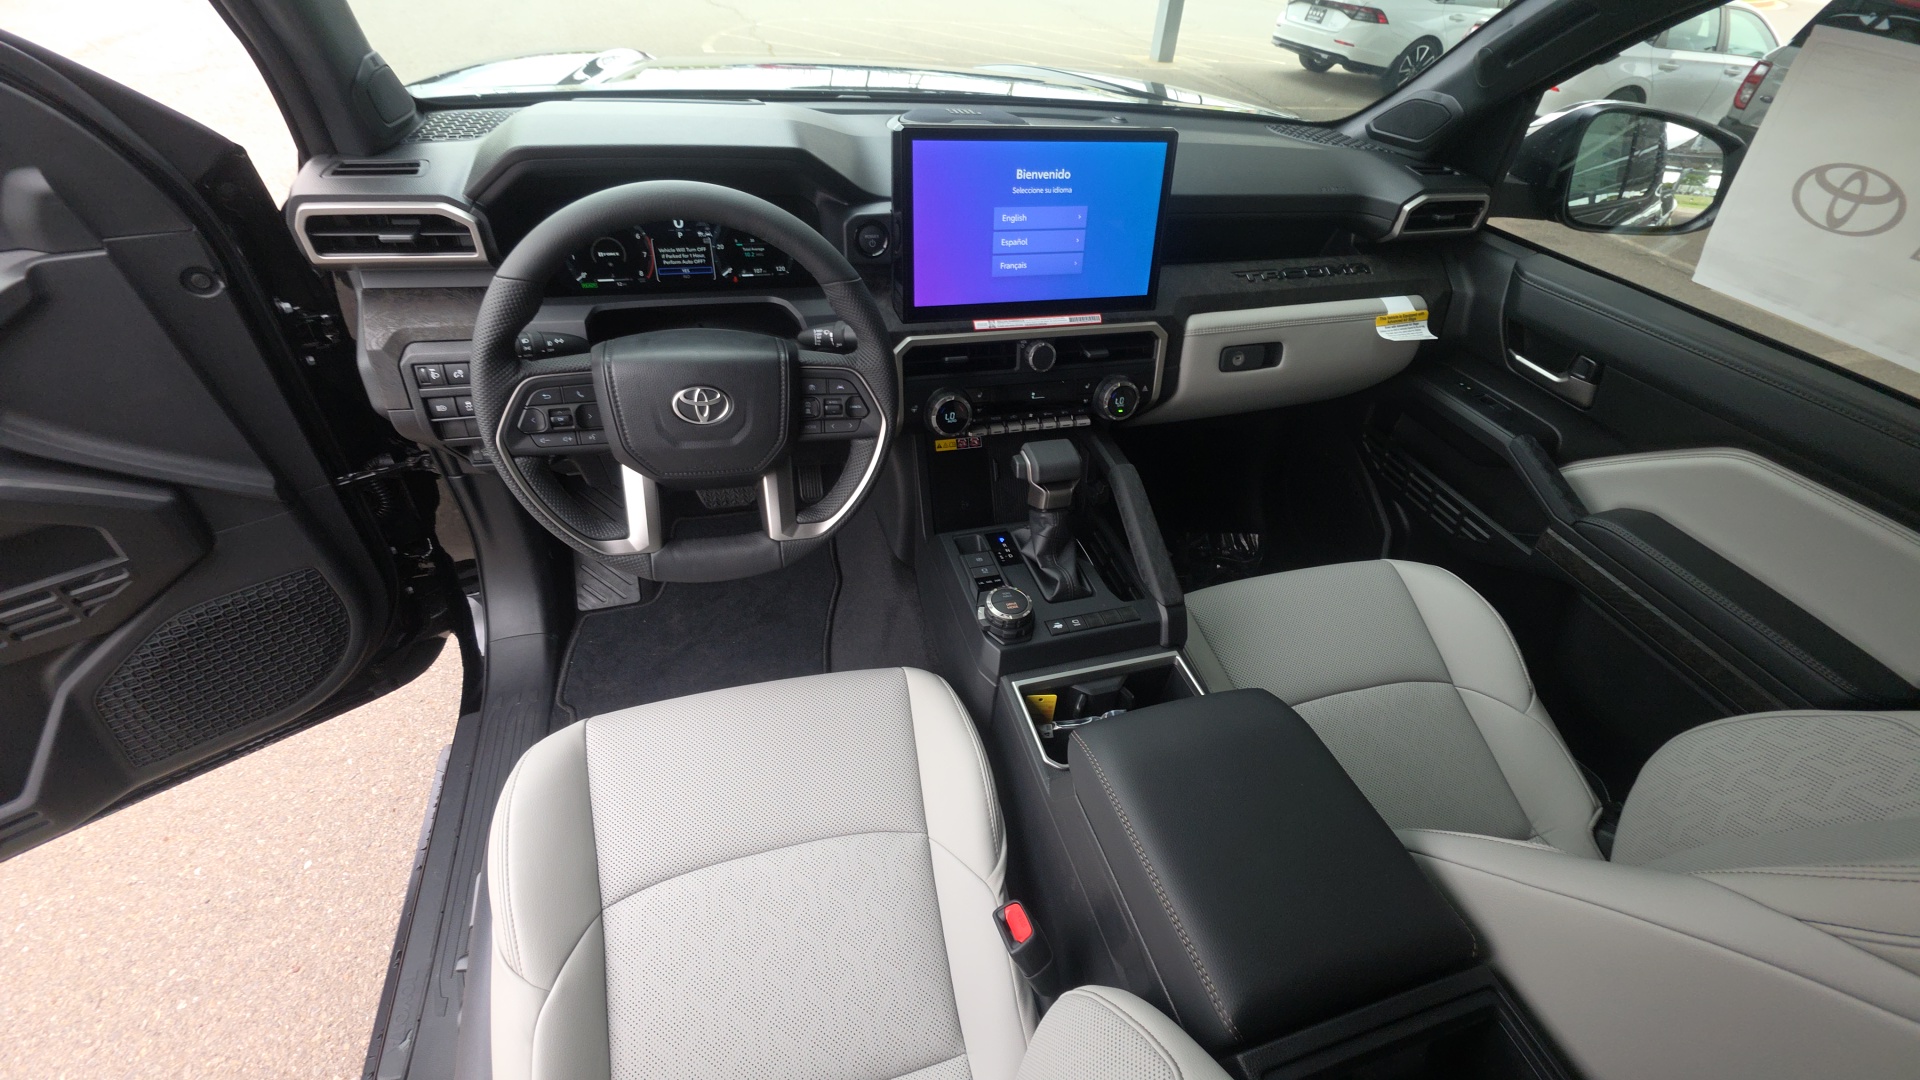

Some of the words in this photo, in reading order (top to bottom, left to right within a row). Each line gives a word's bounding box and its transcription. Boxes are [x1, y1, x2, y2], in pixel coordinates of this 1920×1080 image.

[1016, 168, 1072, 180] Bienvenido
[1012, 187, 1044, 195] Seleccione
[1002, 214, 1027, 224] English
[1001, 238, 1028, 247] Español
[1000, 262, 1027, 270] Français
[1231, 263, 1372, 282] TACOMA
